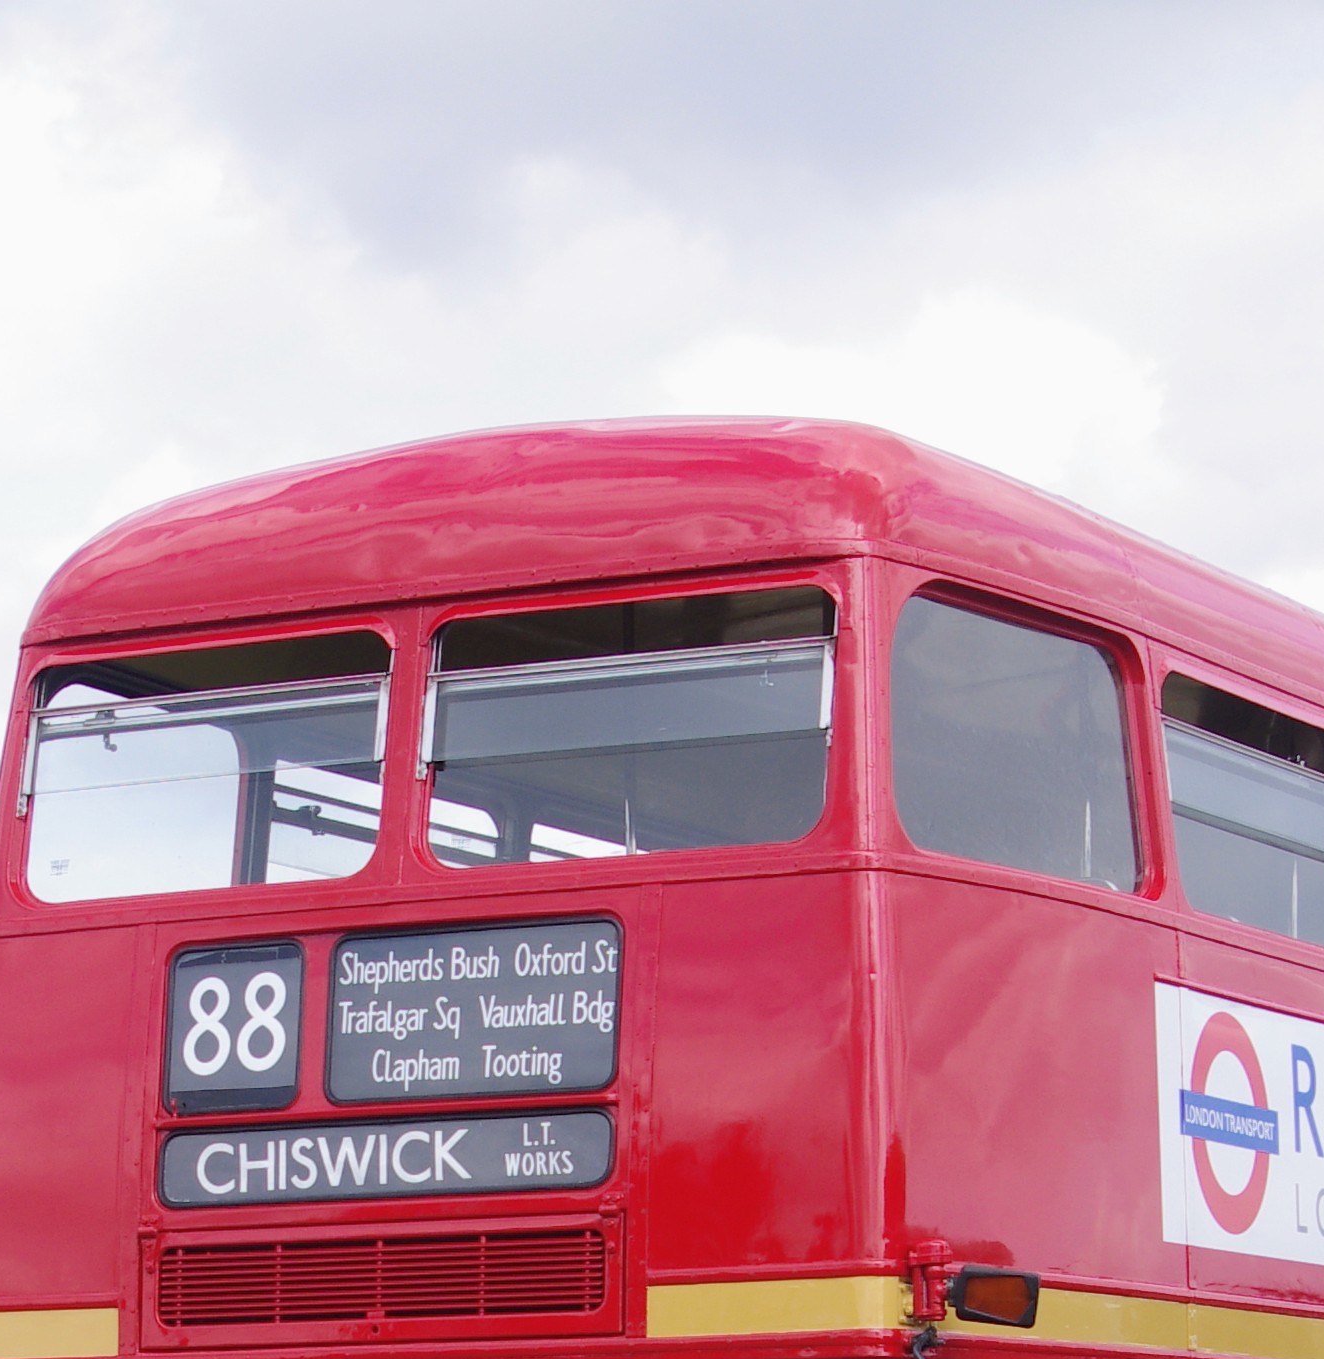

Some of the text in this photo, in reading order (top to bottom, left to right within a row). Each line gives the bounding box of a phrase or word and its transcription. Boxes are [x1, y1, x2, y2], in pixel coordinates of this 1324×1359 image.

[338, 940, 618, 994] Shepherds Bush Oxford St
[182, 972, 287, 1077] 88
[338, 991, 615, 1041] Trafalgar Sq Vauxhall Bdg
[372, 1044, 563, 1091] Clapham Tooting
[522, 1121, 556, 1148] L.T.
[1184, 1103, 1275, 1141] LONDON TRANSPORT
[196, 1128, 473, 1195] CHISWICK
[504, 1150, 575, 1178] WORKS
